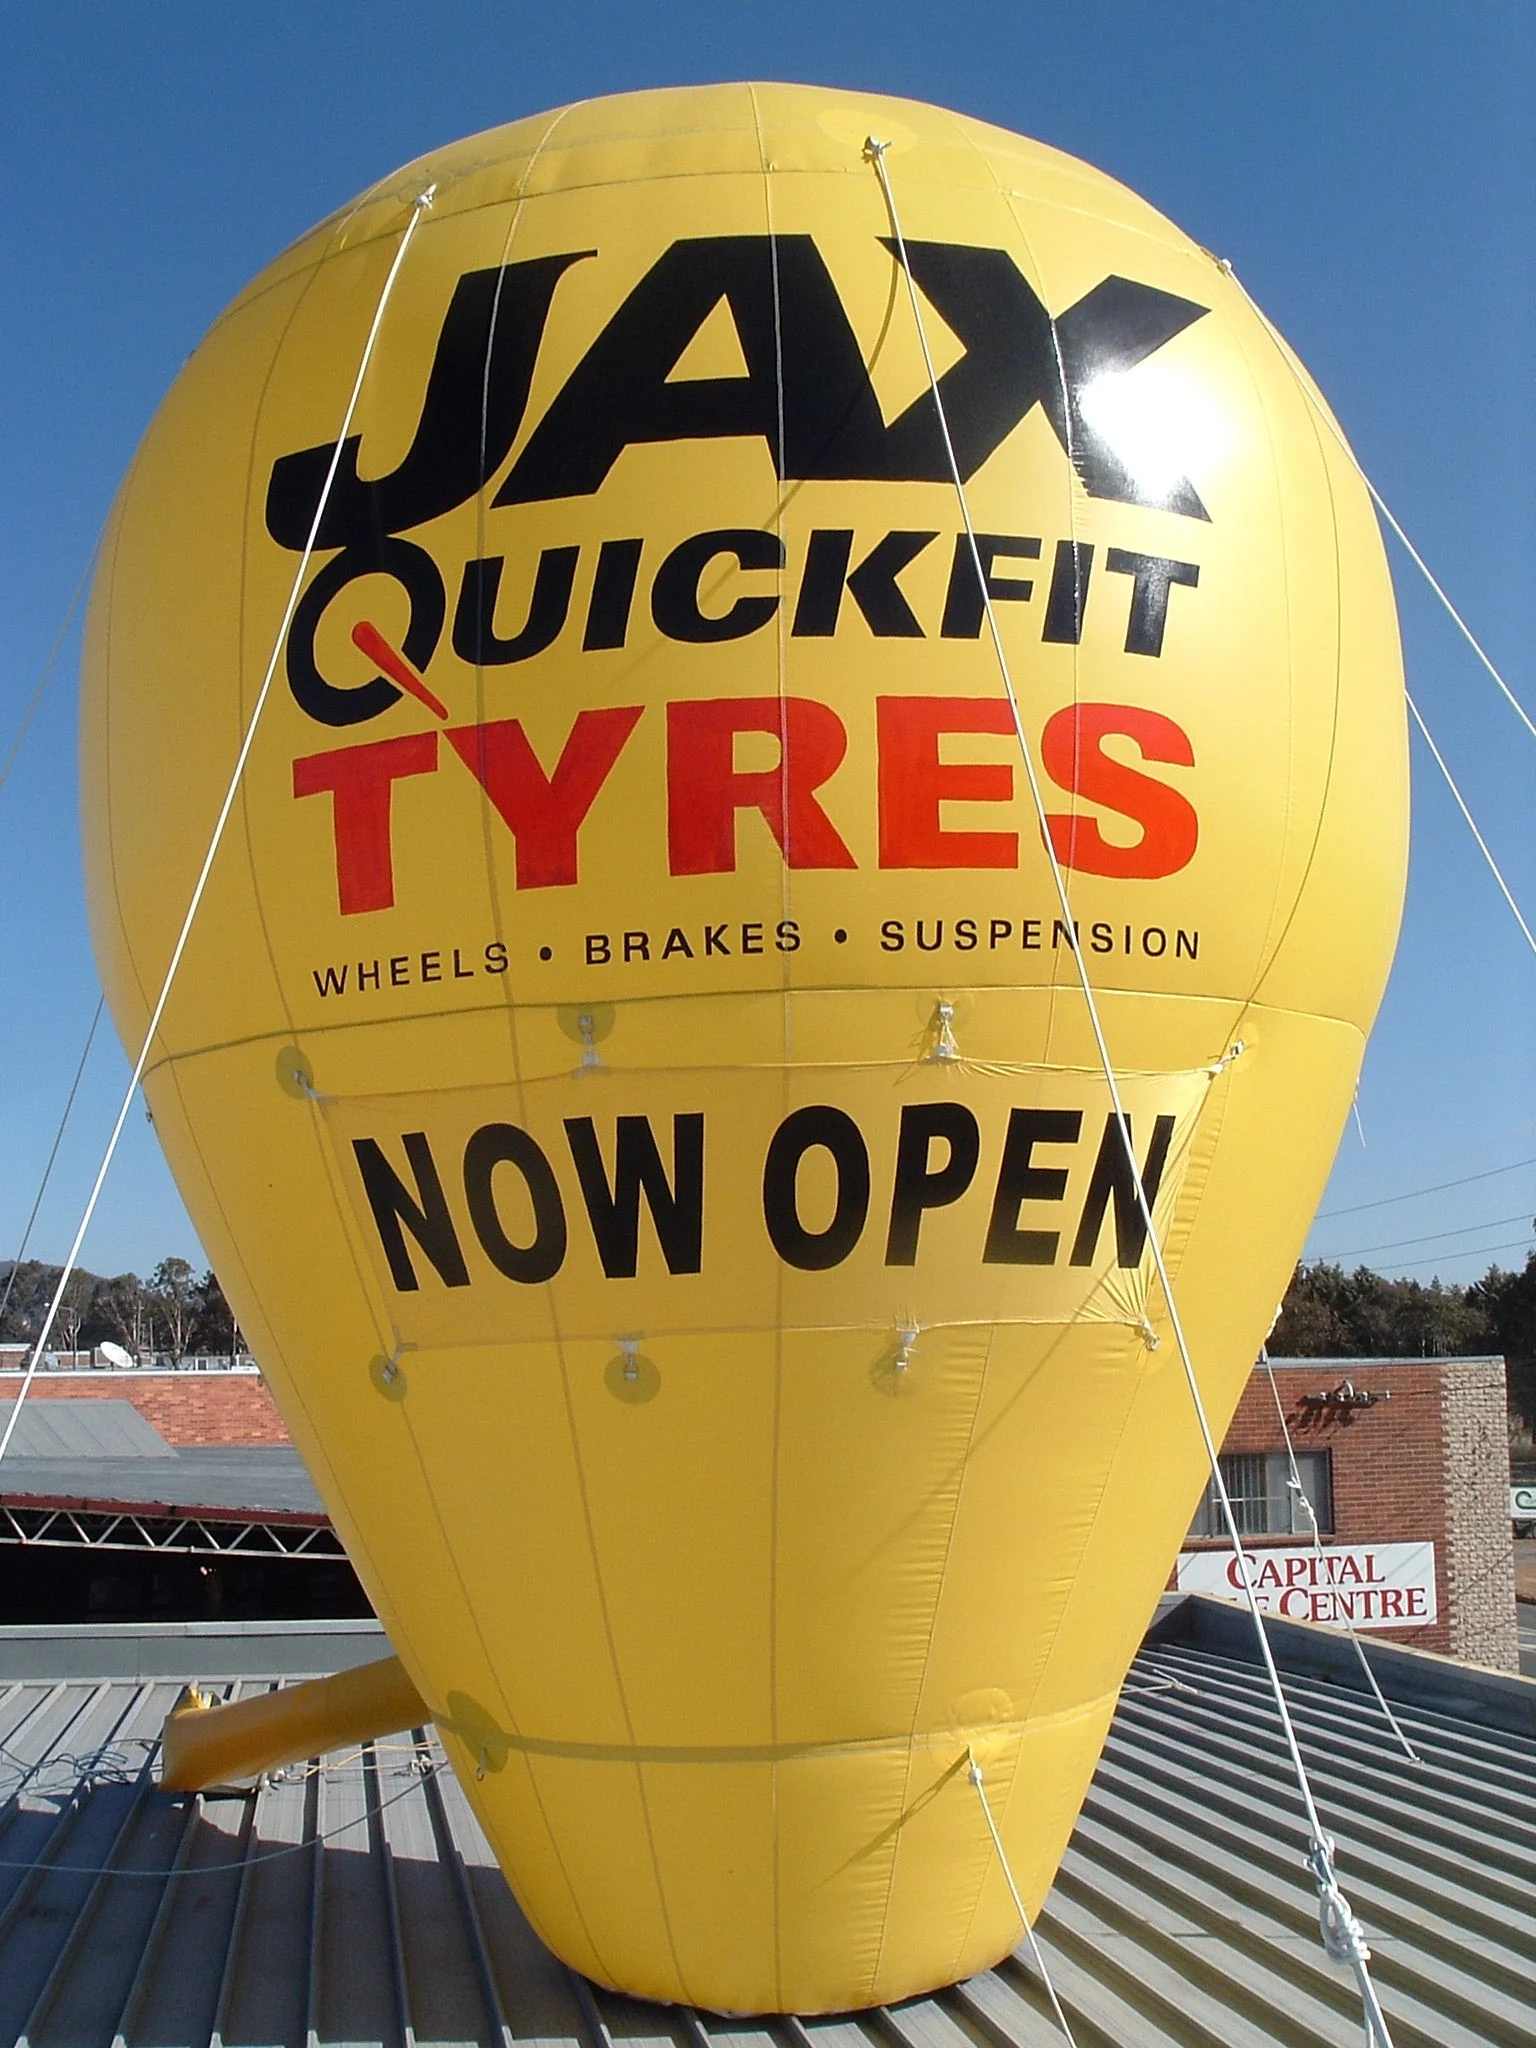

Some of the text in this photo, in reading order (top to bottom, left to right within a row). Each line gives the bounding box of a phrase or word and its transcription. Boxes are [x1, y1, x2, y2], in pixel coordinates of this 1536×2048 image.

[266, 233, 1213, 549] JAX
[286, 528, 1199, 727] QUICKFIT
[293, 696, 1199, 915] TYRES
[313, 919, 1199, 997] WHEELS BRAKES SUSPENSION
[352, 1101, 1176, 1292] NOW OPEN
[1226, 1554, 1386, 1590] CAPITAL
[1279, 1587, 1428, 1622] CENTRE
